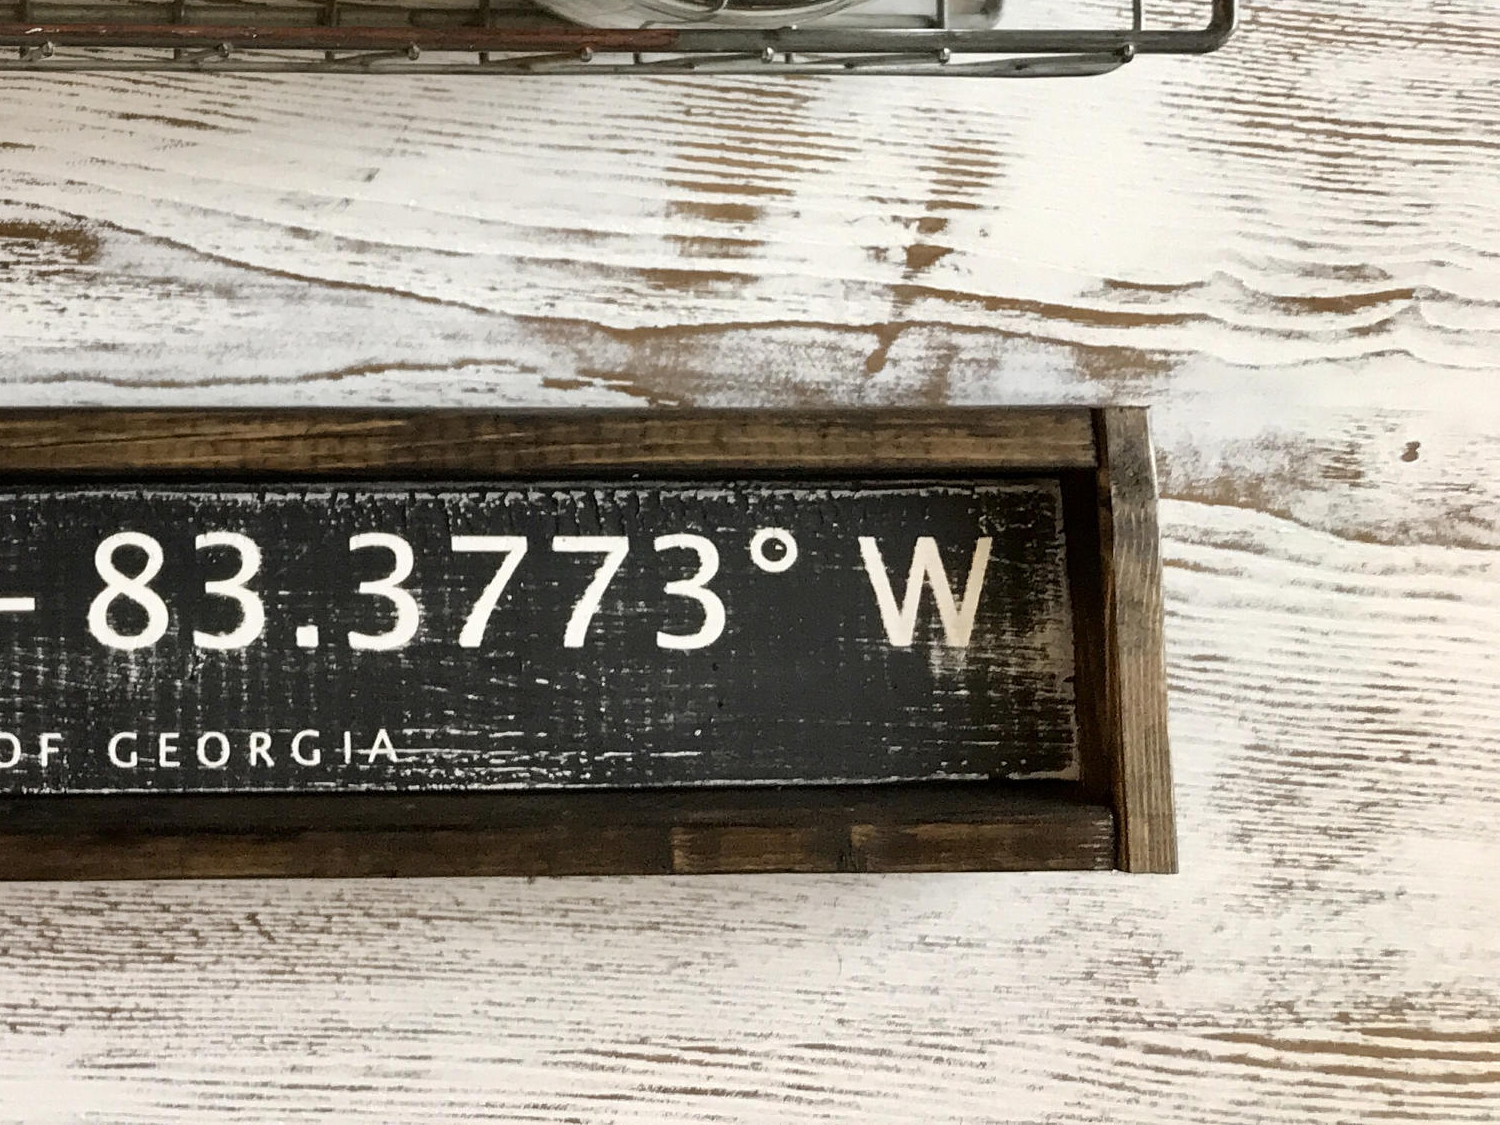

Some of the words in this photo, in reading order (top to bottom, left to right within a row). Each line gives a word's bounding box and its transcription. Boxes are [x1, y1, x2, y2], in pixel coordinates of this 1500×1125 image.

[85, 527, 799, 652] 83.3773°
[857, 535, 992, 649] W
[106, 727, 400, 770] GEORGIA
